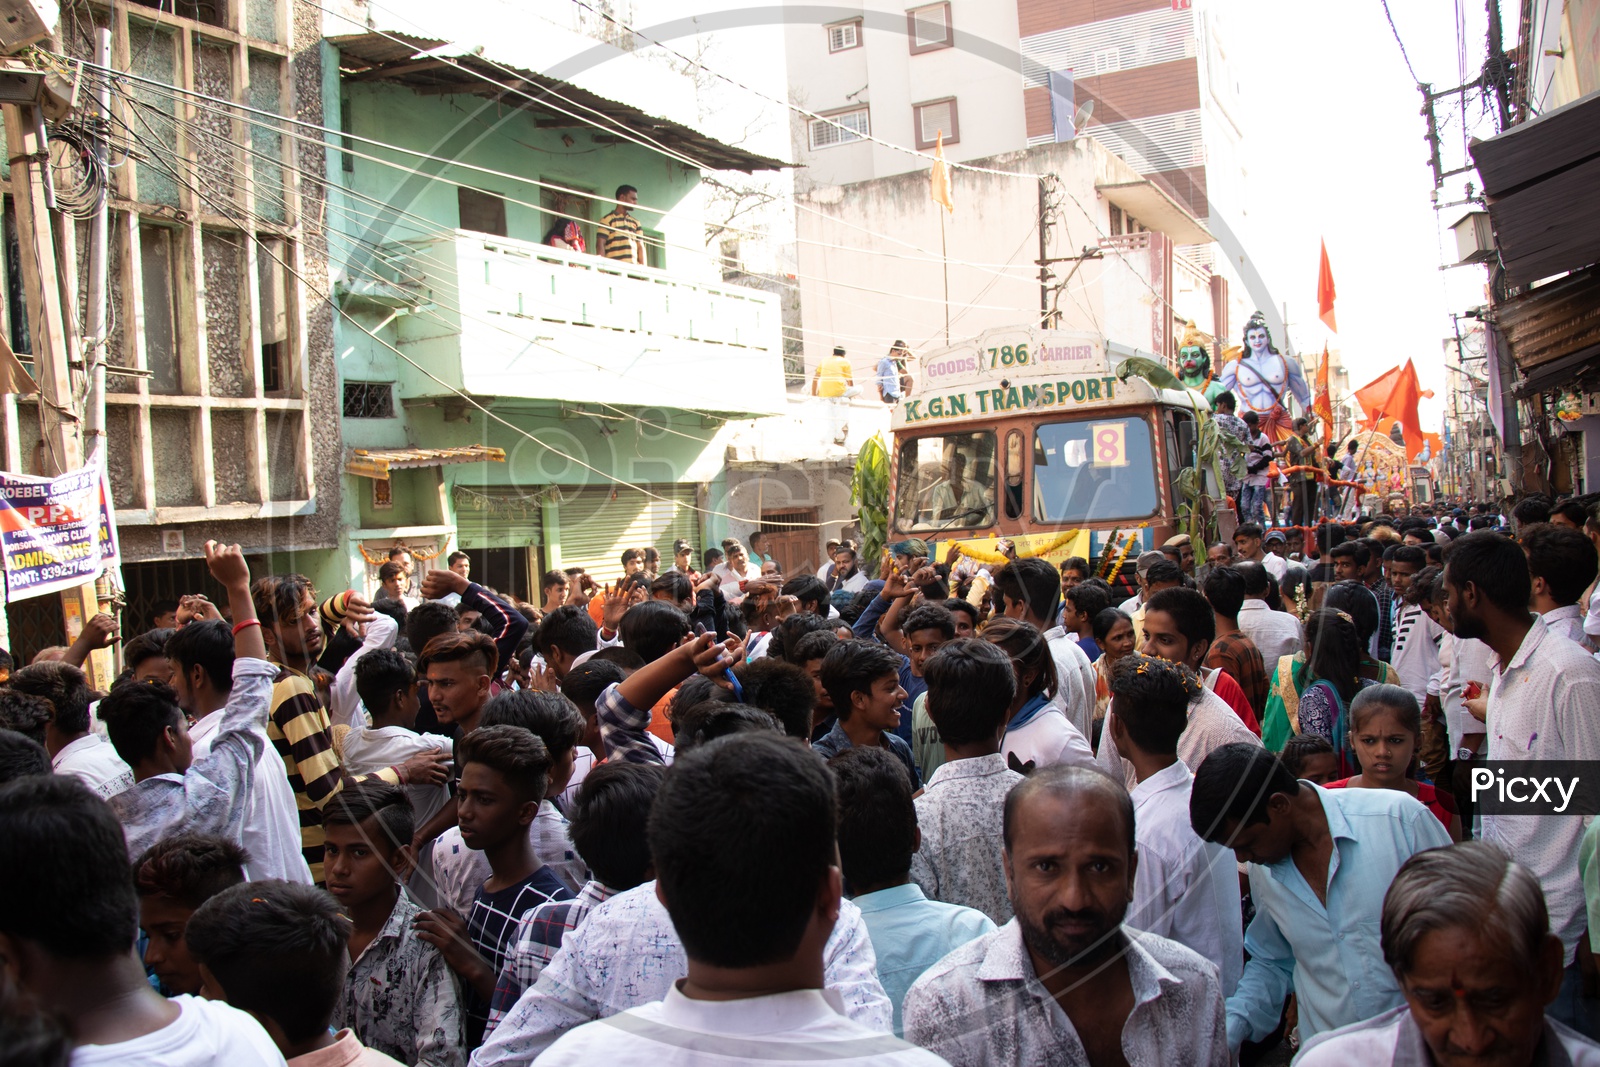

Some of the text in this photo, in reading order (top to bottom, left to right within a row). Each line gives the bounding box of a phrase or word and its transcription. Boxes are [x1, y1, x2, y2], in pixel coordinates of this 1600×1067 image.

[927, 343, 1092, 378] GOODS 786 CARRIER
[904, 376, 1117, 423] K.G.N. TRANSPORT
[1097, 429, 1119, 462] 8
[7, 541, 91, 570] ADMISSIONS
[9, 571, 40, 587] CONT:
